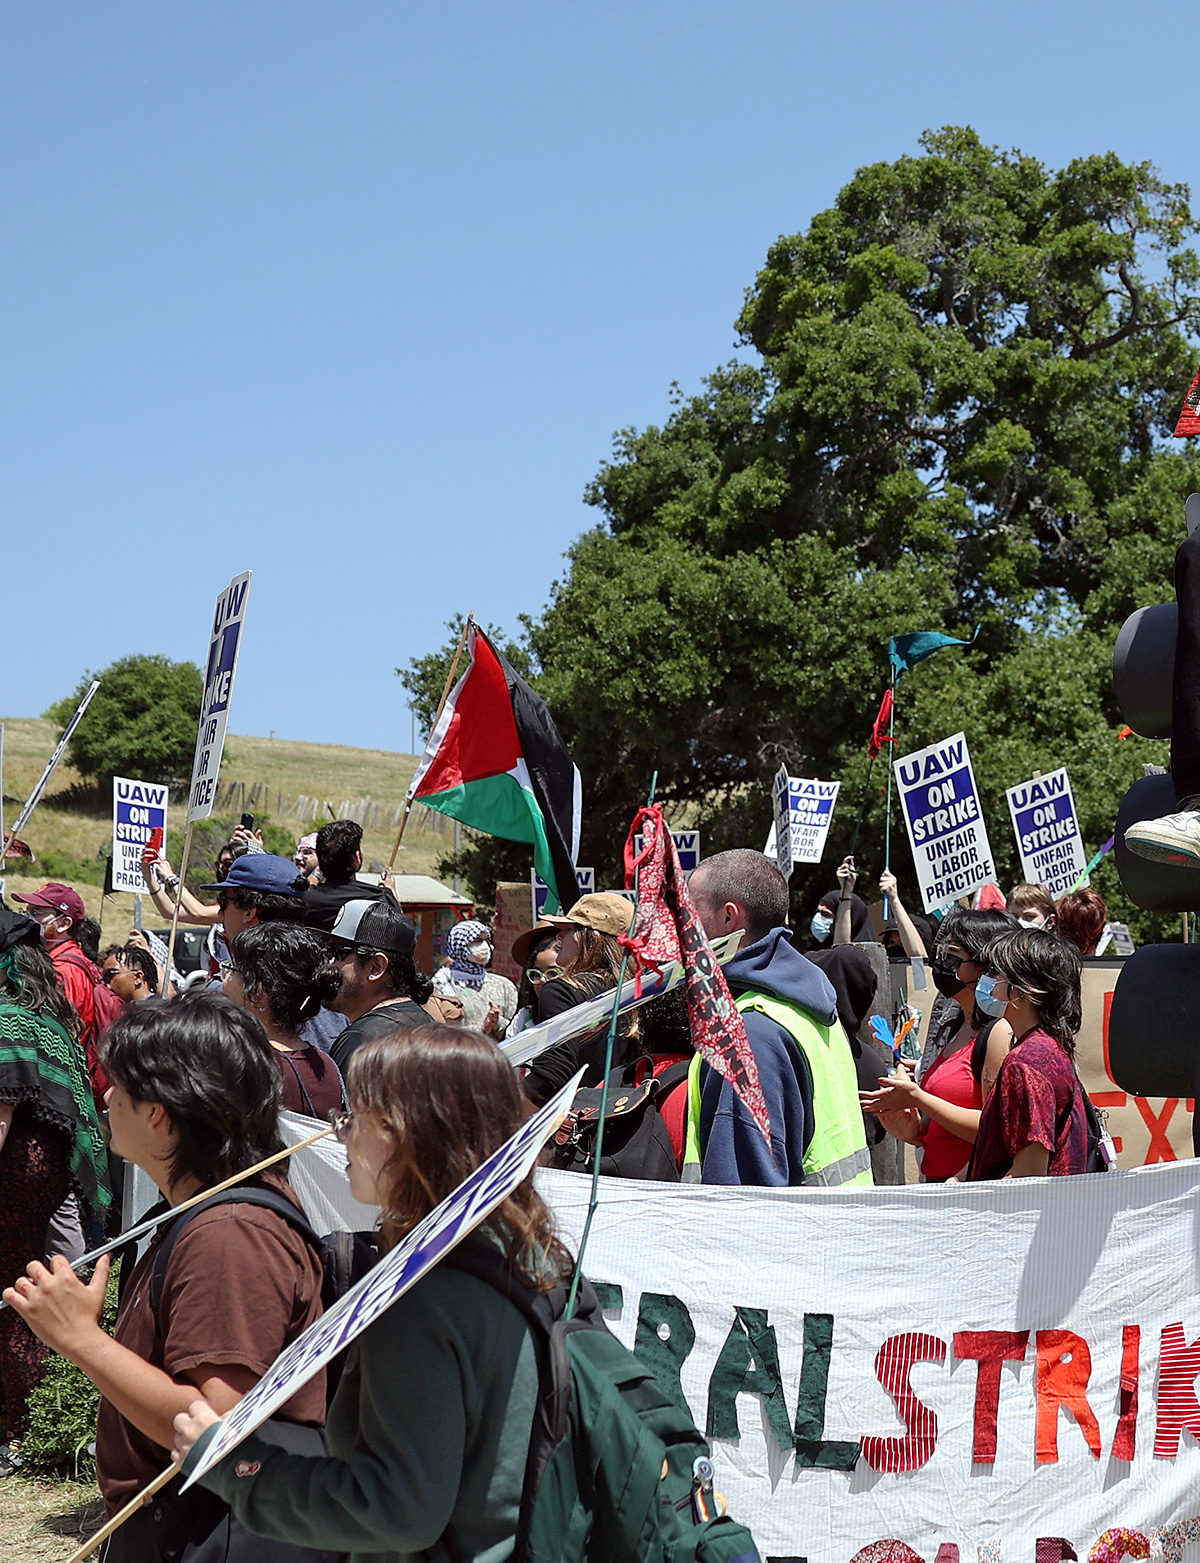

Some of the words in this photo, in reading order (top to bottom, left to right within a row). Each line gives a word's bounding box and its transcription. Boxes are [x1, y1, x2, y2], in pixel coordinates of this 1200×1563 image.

[900, 740, 963, 786] UAW
[118, 782, 165, 805] UAW
[789, 781, 838, 796] UAW
[927, 778, 957, 808] ON
[1011, 773, 1064, 809] UAW
[129, 807, 149, 825] ON
[797, 798, 820, 812] ON
[1033, 803, 1057, 826] ON
[790, 809, 829, 827] TRIKE
[912, 795, 978, 841] STRIKE
[117, 822, 152, 843] STRI
[790, 826, 819, 838] NFAIR
[792, 838, 815, 847] BOR
[925, 827, 977, 862] UNFAIR
[1022, 817, 1076, 853] STRIKE
[122, 845, 145, 858] UNF
[770, 844, 820, 858] PCTICE
[932, 847, 979, 880] LABOR
[1032, 842, 1075, 869] UNFAIR
[116, 872, 146, 886] PRACT
[926, 860, 993, 903] PRACTICE
[1037, 857, 1076, 884] LABOR
[675, 905, 722, 1000] ABOR
[592, 1280, 861, 1471] RAL
